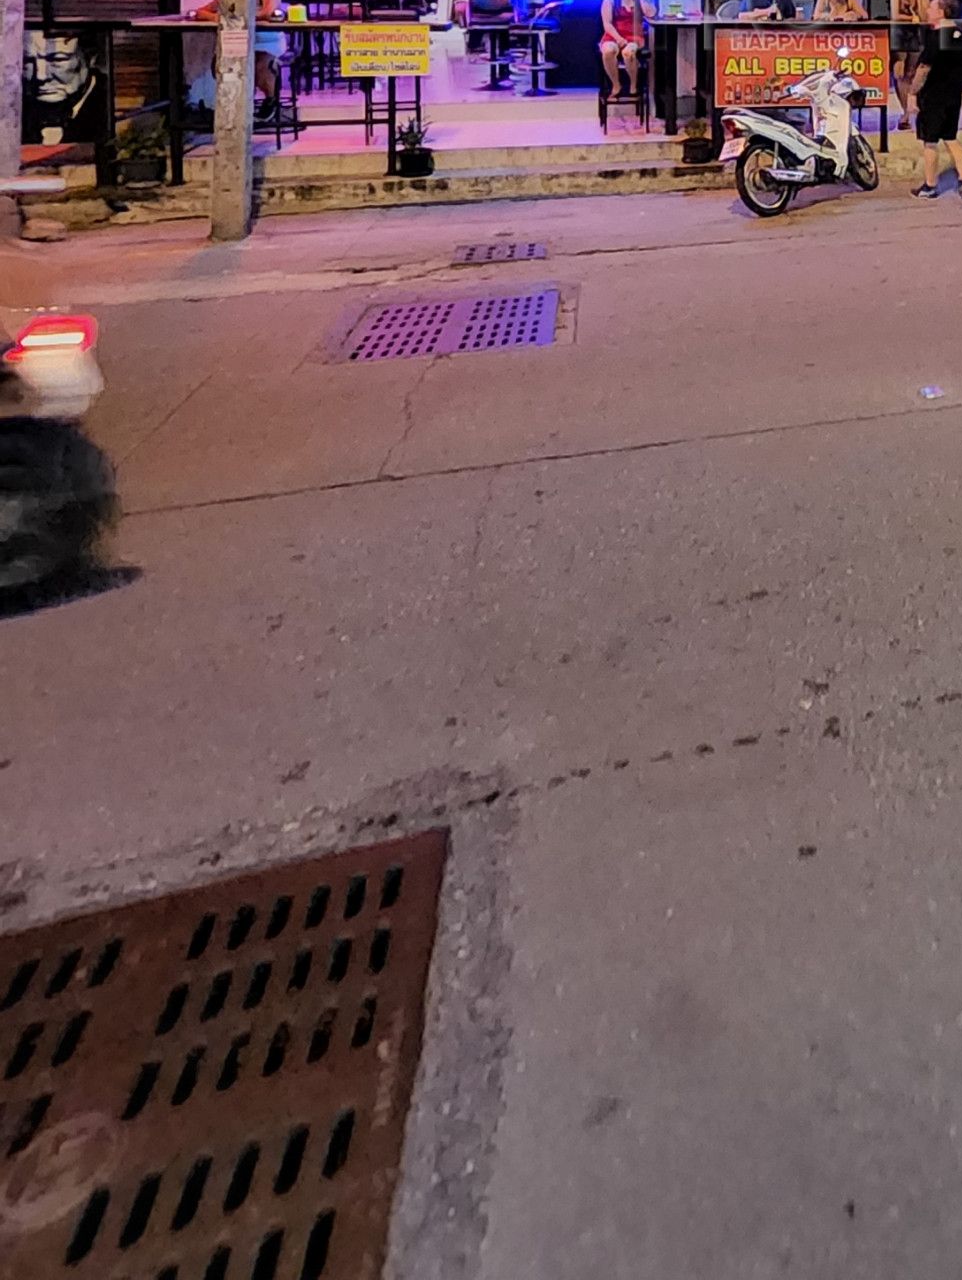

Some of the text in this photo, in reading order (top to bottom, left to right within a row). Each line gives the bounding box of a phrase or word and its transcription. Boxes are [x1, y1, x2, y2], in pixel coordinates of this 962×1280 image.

[731, 32, 876, 51] HAPPY HOUR
[724, 57, 766, 76] ALL
